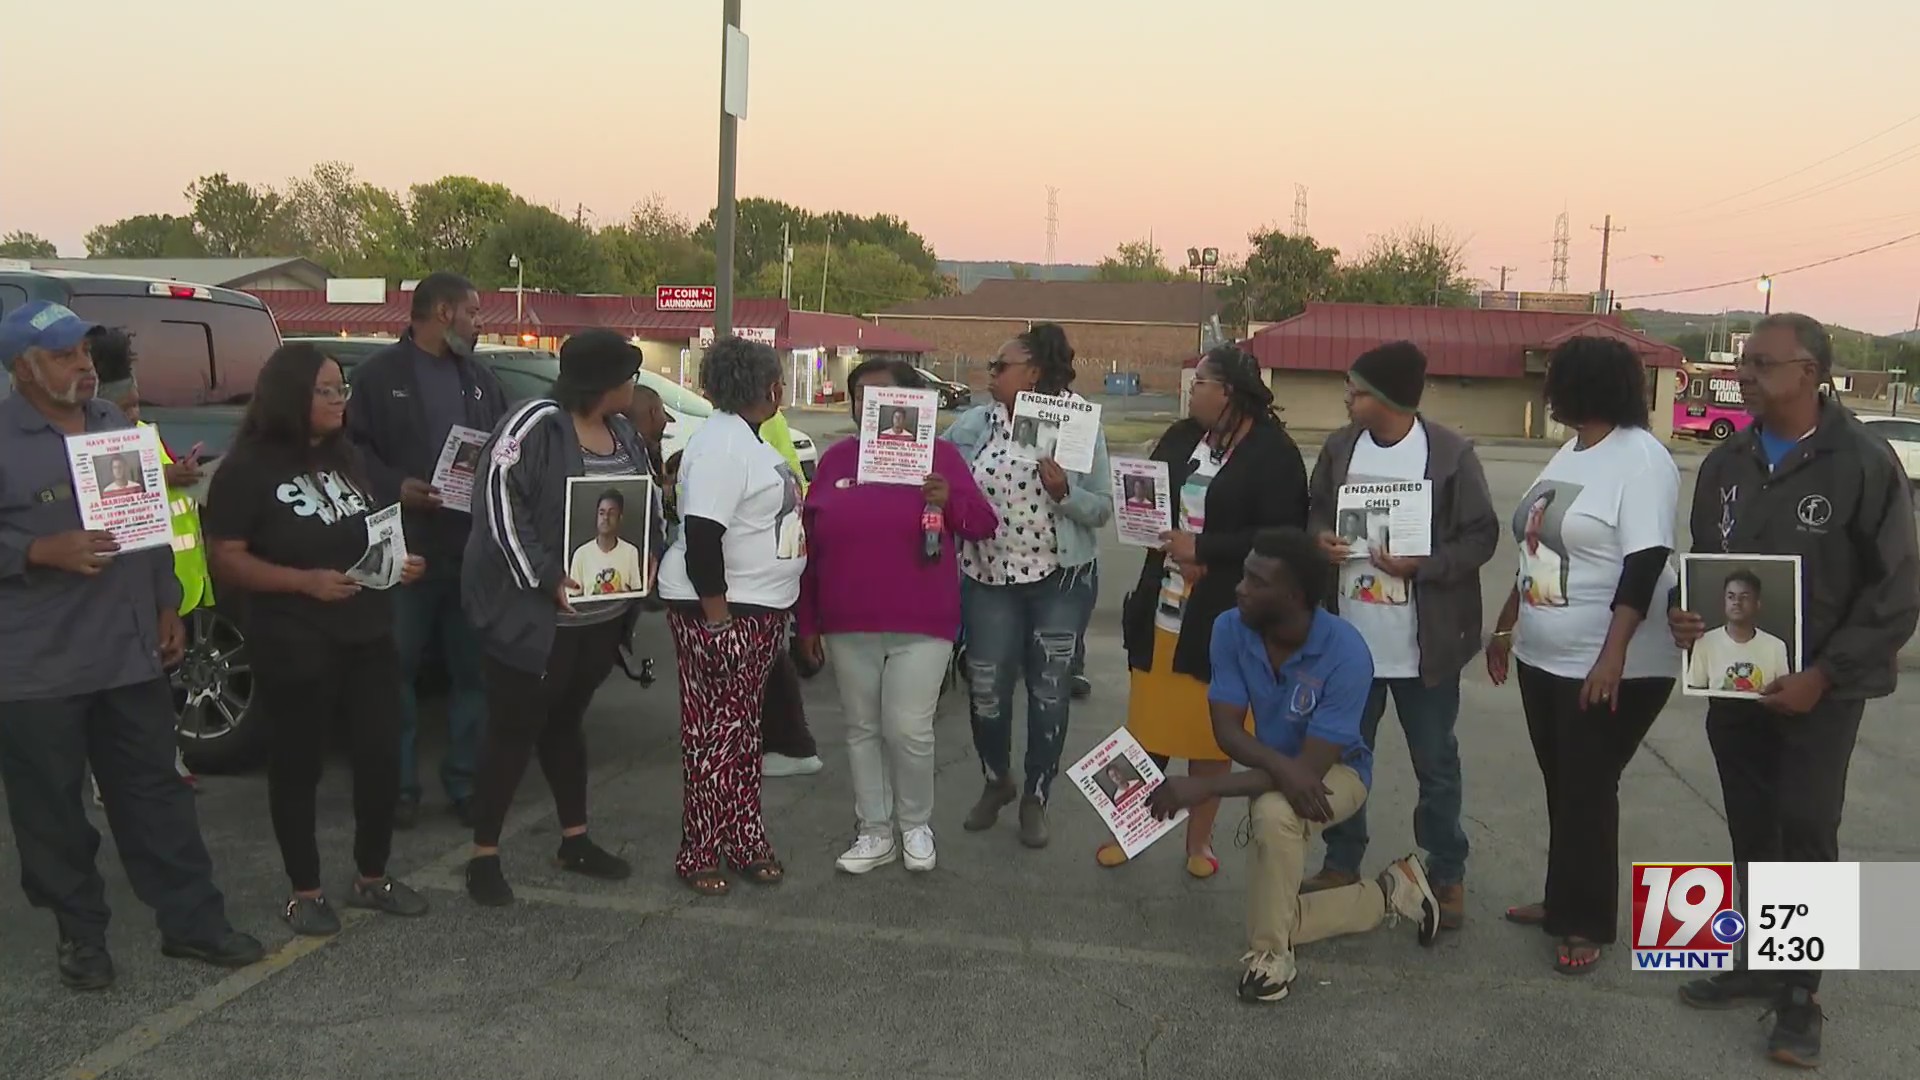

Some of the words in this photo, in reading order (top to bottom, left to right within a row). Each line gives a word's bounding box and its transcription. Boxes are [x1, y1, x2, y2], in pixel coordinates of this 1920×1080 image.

[674, 289, 699, 298] COIN
[660, 299, 713, 308] LAUNDROMAT
[747, 328, 764, 338] Dry
[1021, 393, 1093, 412] ENDANGERED
[1037, 410, 1070, 422] CHILD
[86, 437, 105, 447] HAVE
[108, 436, 121, 444] YOU
[1344, 483, 1422, 494] ENDANGERED
[101, 496, 135, 506] MARIOUS
[136, 492, 161, 501] LOGAN
[1365, 499, 1400, 508] CHILD
